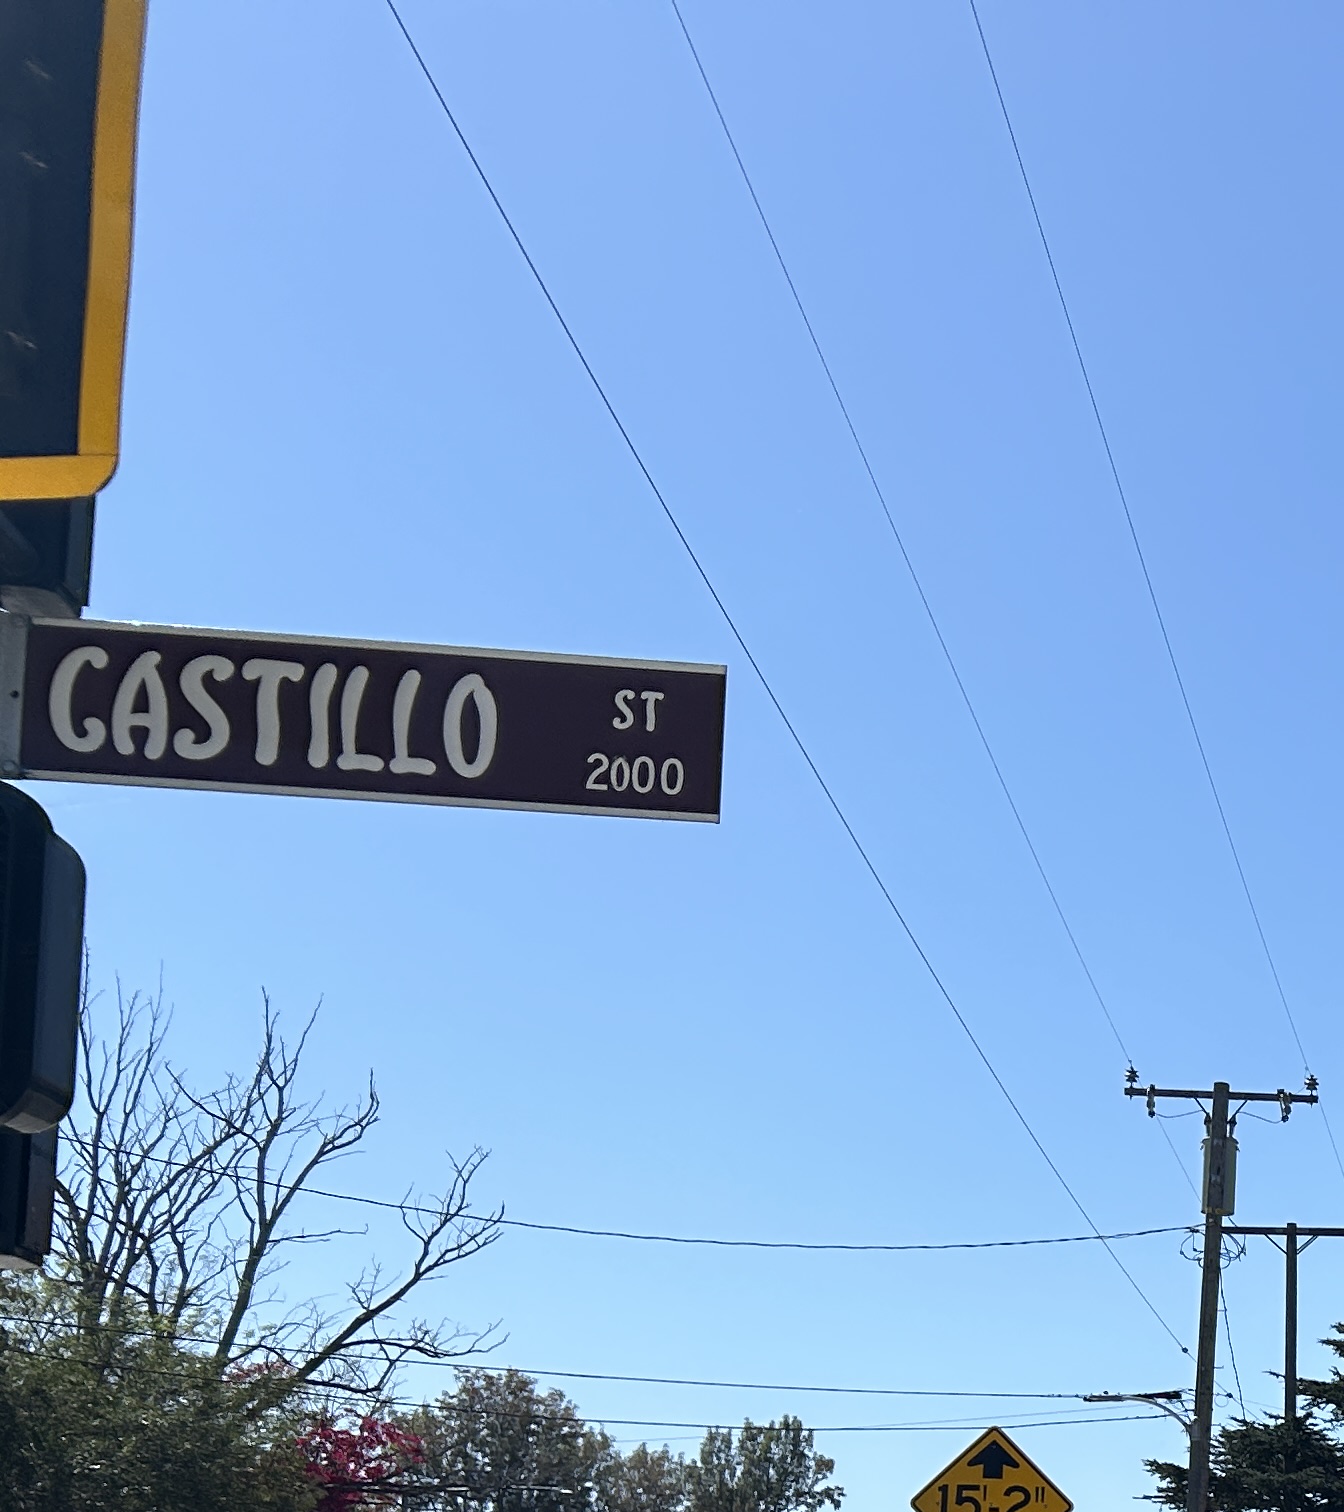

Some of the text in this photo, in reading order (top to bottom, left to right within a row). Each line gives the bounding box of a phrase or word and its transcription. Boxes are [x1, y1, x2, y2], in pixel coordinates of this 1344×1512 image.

[48, 645, 666, 779] CASTILLO ST
[585, 752, 686, 796] 2000
